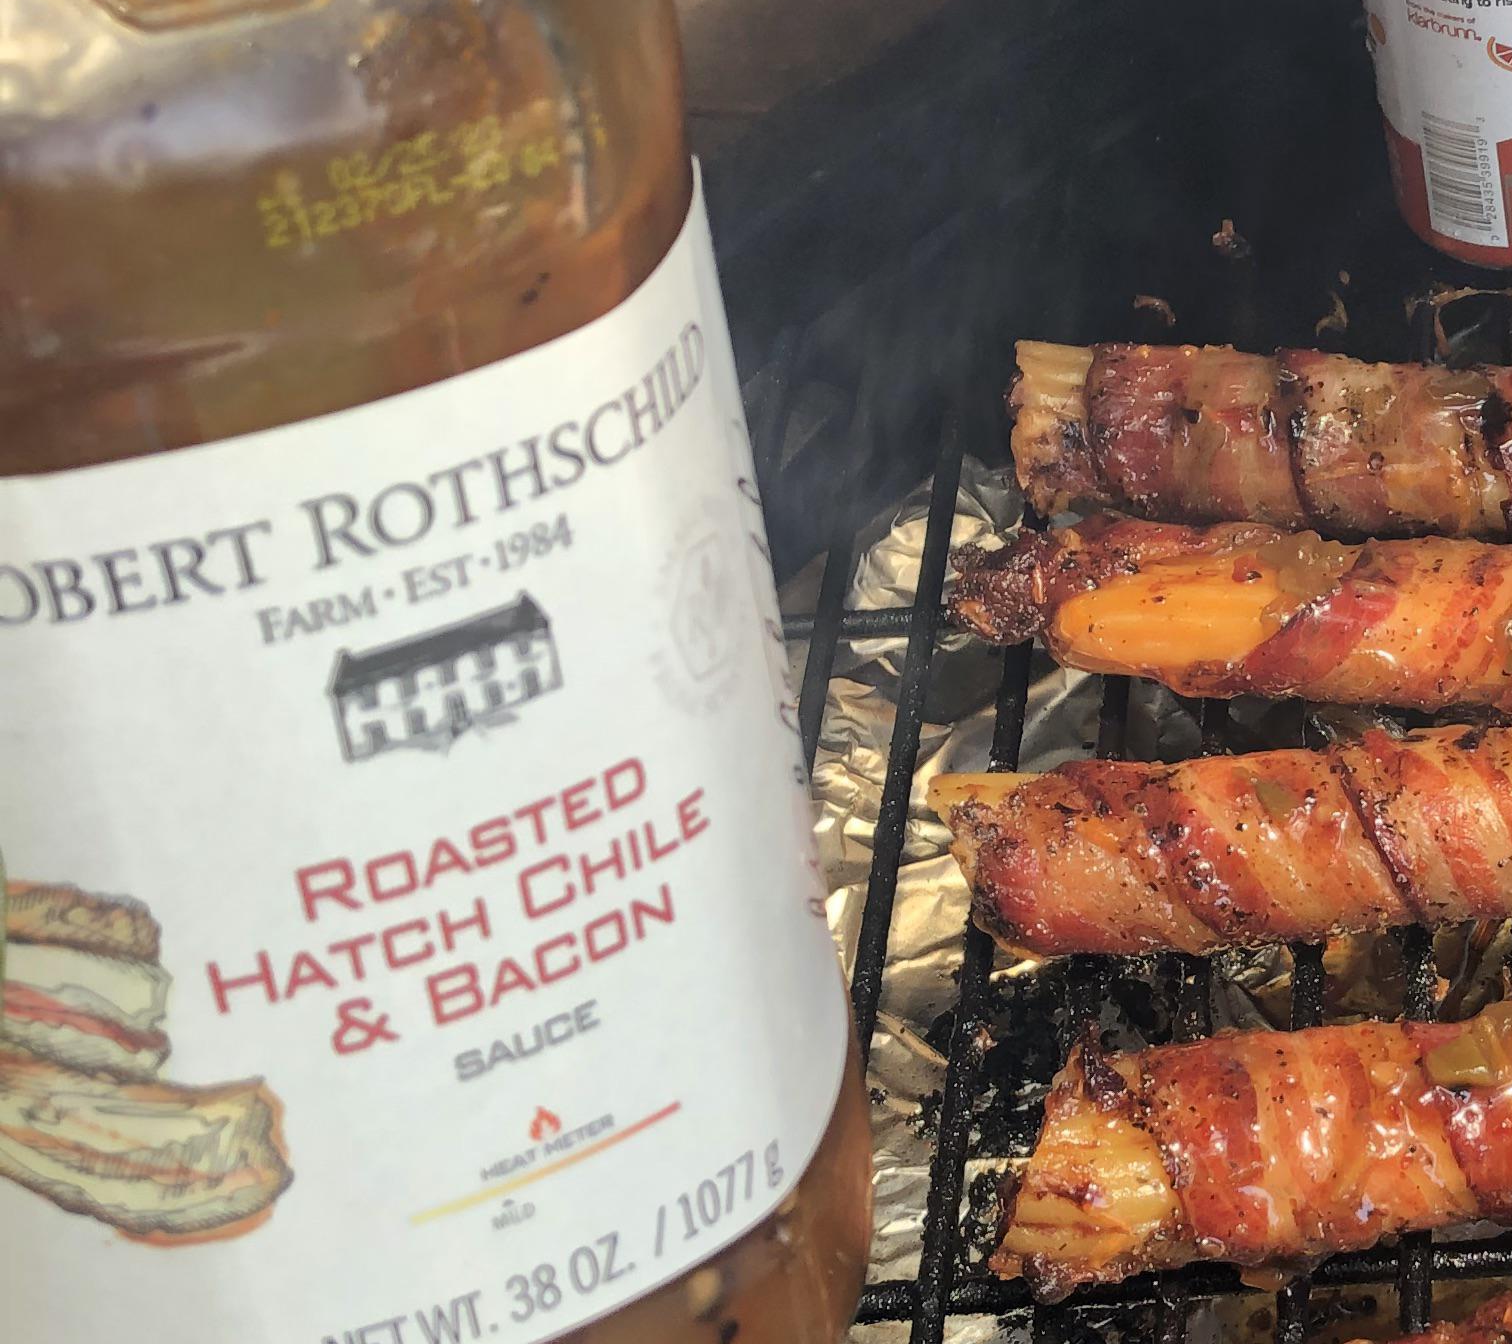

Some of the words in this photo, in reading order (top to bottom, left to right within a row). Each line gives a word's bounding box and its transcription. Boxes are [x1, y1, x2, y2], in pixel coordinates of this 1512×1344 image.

[299, 319, 705, 571] ROTHSCHILD
[206, 897, 492, 1014] HATCH
[517, 787, 710, 920] CHILE
[294, 757, 646, 923] ROASTED
[332, 996, 400, 1056] &
[425, 883, 674, 1026] BACON
[453, 999, 601, 1082] SAUCE
[480, 1147, 537, 1182] HEAT
[543, 1113, 616, 1158] METER
[492, 1201, 536, 1231] MILD
[505, 1263, 562, 1324] 38
[568, 1231, 636, 1295] OZ.
[677, 1150, 754, 1241] 1077
[764, 1139, 784, 1189] g
